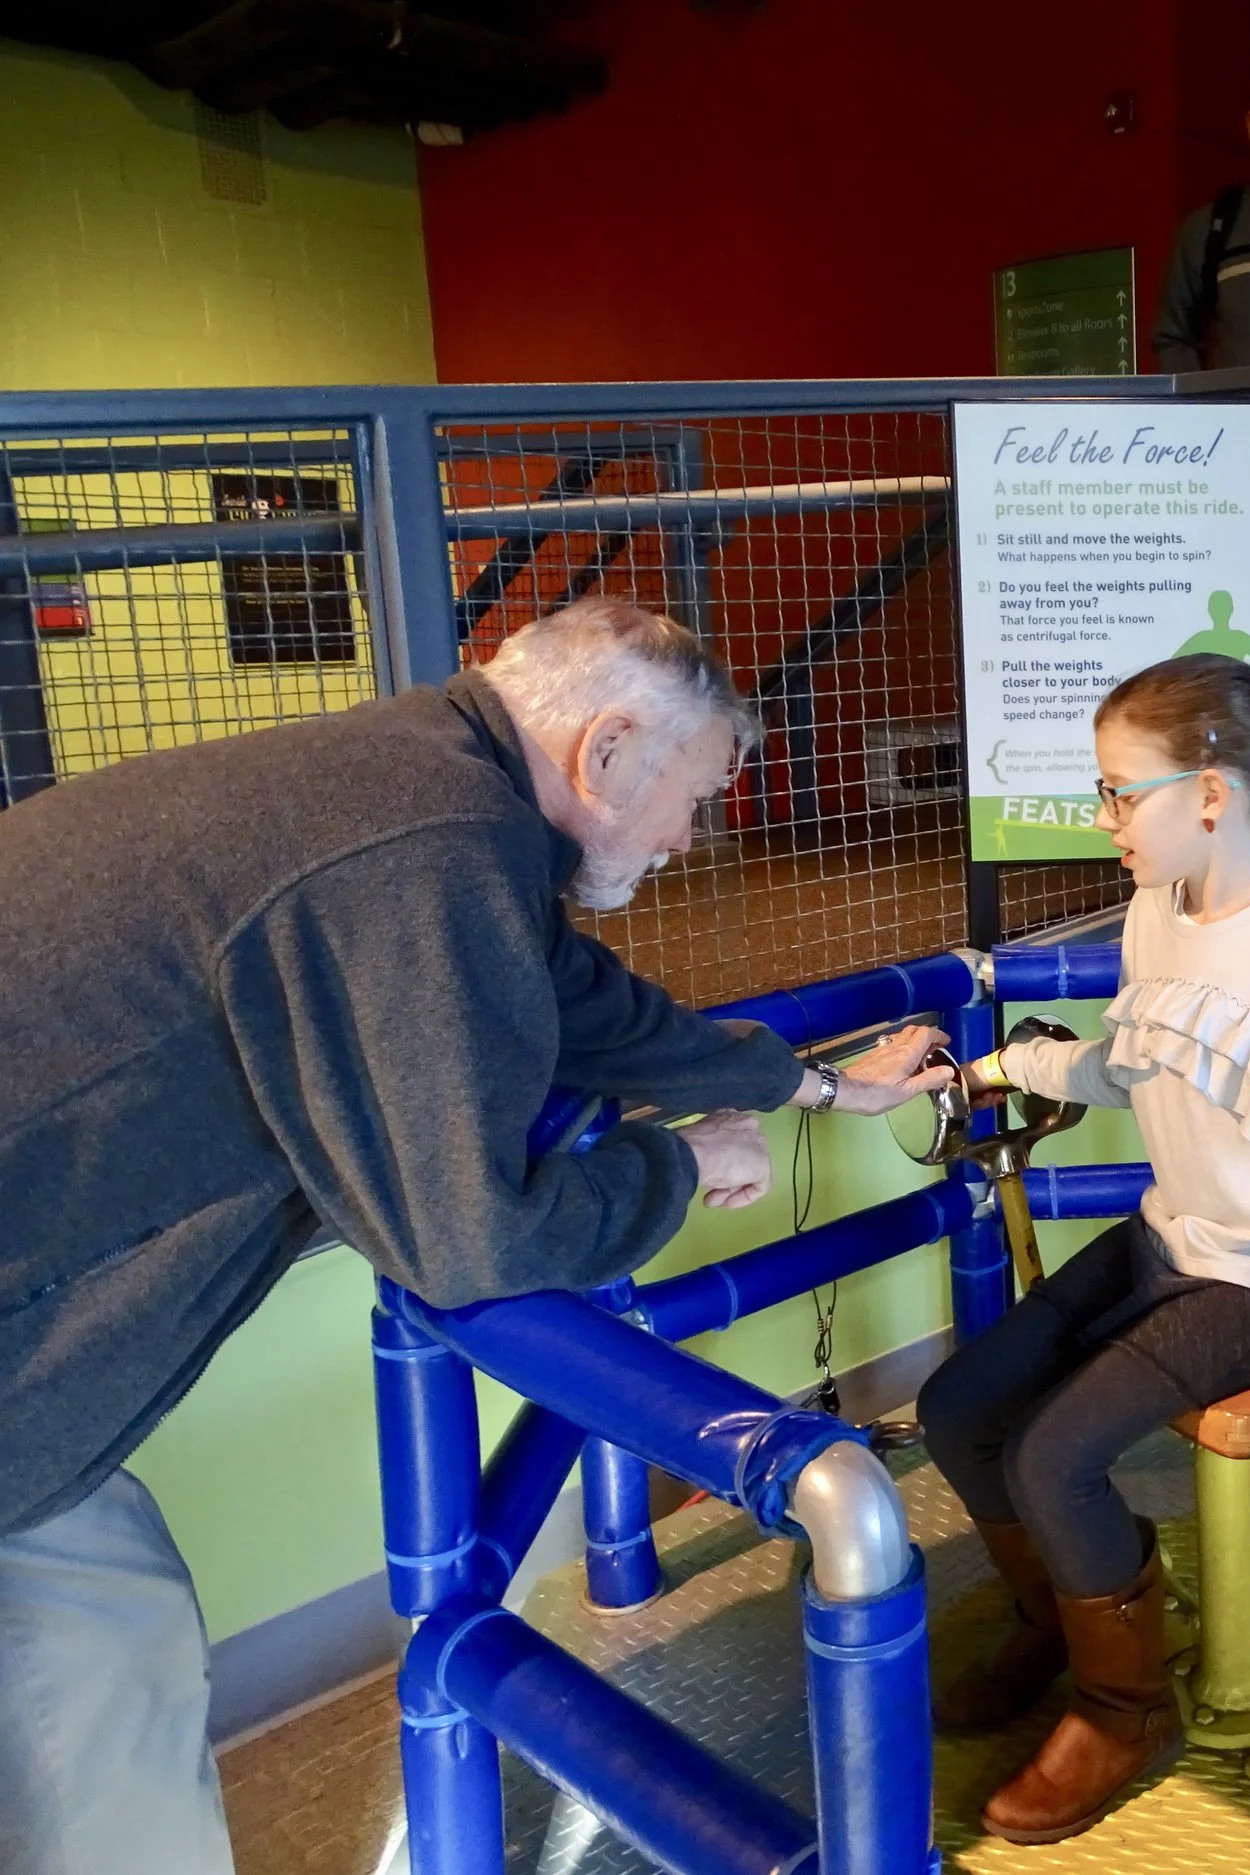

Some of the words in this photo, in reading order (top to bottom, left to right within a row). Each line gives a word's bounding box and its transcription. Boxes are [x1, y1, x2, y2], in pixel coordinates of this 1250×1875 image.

[1059, 323, 1070, 334] to
[1071, 320, 1082, 332] all
[1084, 317, 1113, 330] floors
[993, 426, 1068, 464] Feel
[1069, 430, 1114, 464] the
[1123, 427, 1224, 467] Force!
[994, 481, 1007, 495] A
[1012, 479, 1052, 495] staff
[1058, 480, 1133, 495] member
[1139, 480, 1182, 495] must
[1188, 479, 1209, 494] be
[995, 501, 1064, 519] present
[1070, 501, 1087, 516] to
[1092, 501, 1161, 519] operate
[1166, 499, 1199, 515] this
[1204, 499, 1245, 515] ride.
[976, 532, 987, 546] 1)
[997, 533, 1015, 545] Sit
[1018, 533, 1042, 545] still
[1046, 533, 1069, 545] and
[1072, 535, 1107, 545] move
[1109, 533, 1130, 545] the
[1133, 532, 1186, 547] weights.
[997, 551, 1026, 562] What
[1030, 551, 1077, 564] happens
[1079, 551, 1110, 561] when
[1112, 552, 1132, 564] you
[1135, 550, 1165, 563] begin
[1168, 550, 1180, 560] to
[1182, 549, 1212, 563] spin?
[978, 580, 991, 594] 2)
[999, 581, 1016, 593] Do
[1019, 583, 1041, 595] you
[1045, 581, 1069, 593] feel
[1072, 581, 1093, 592] the
[1096, 580, 1146, 594] weights
[1149, 579, 1192, 594] pulling
[999, 599, 1032, 611] away
[1035, 597, 1066, 609] from
[1069, 597, 1099, 611] you?
[1000, 615, 1025, 625] That
[1028, 614, 1057, 625] force
[1059, 615, 1079, 627] you
[1081, 614, 1103, 625] feel
[1105, 614, 1116, 624] is
[1118, 614, 1155, 624] known
[1000, 632, 1014, 642] as
[1016, 630, 1077, 644] centrifugal
[1079, 630, 1112, 641] force.
[980, 659, 995, 673] 3)
[1002, 660, 1028, 672] Pull
[1030, 660, 1051, 671] the
[1054, 659, 1103, 673] weights
[1002, 677, 1041, 688] closer
[1045, 677, 1057, 688] to
[1060, 678, 1089, 690] your
[1002, 693, 1031, 705] Does
[1033, 694, 1058, 706] your
[1003, 709, 1037, 722] speed
[1039, 708, 1085, 722] change?
[1004, 749, 1032, 758] When
[1034, 750, 1051, 760] you
[1053, 748, 1075, 758] hold
[1077, 749, 1092, 757] the
[1005, 764, 1021, 773] the
[1046, 763, 1086, 774] allowing
[1087, 764, 1098, 774] yo
[1002, 797, 1096, 828] FEATS
